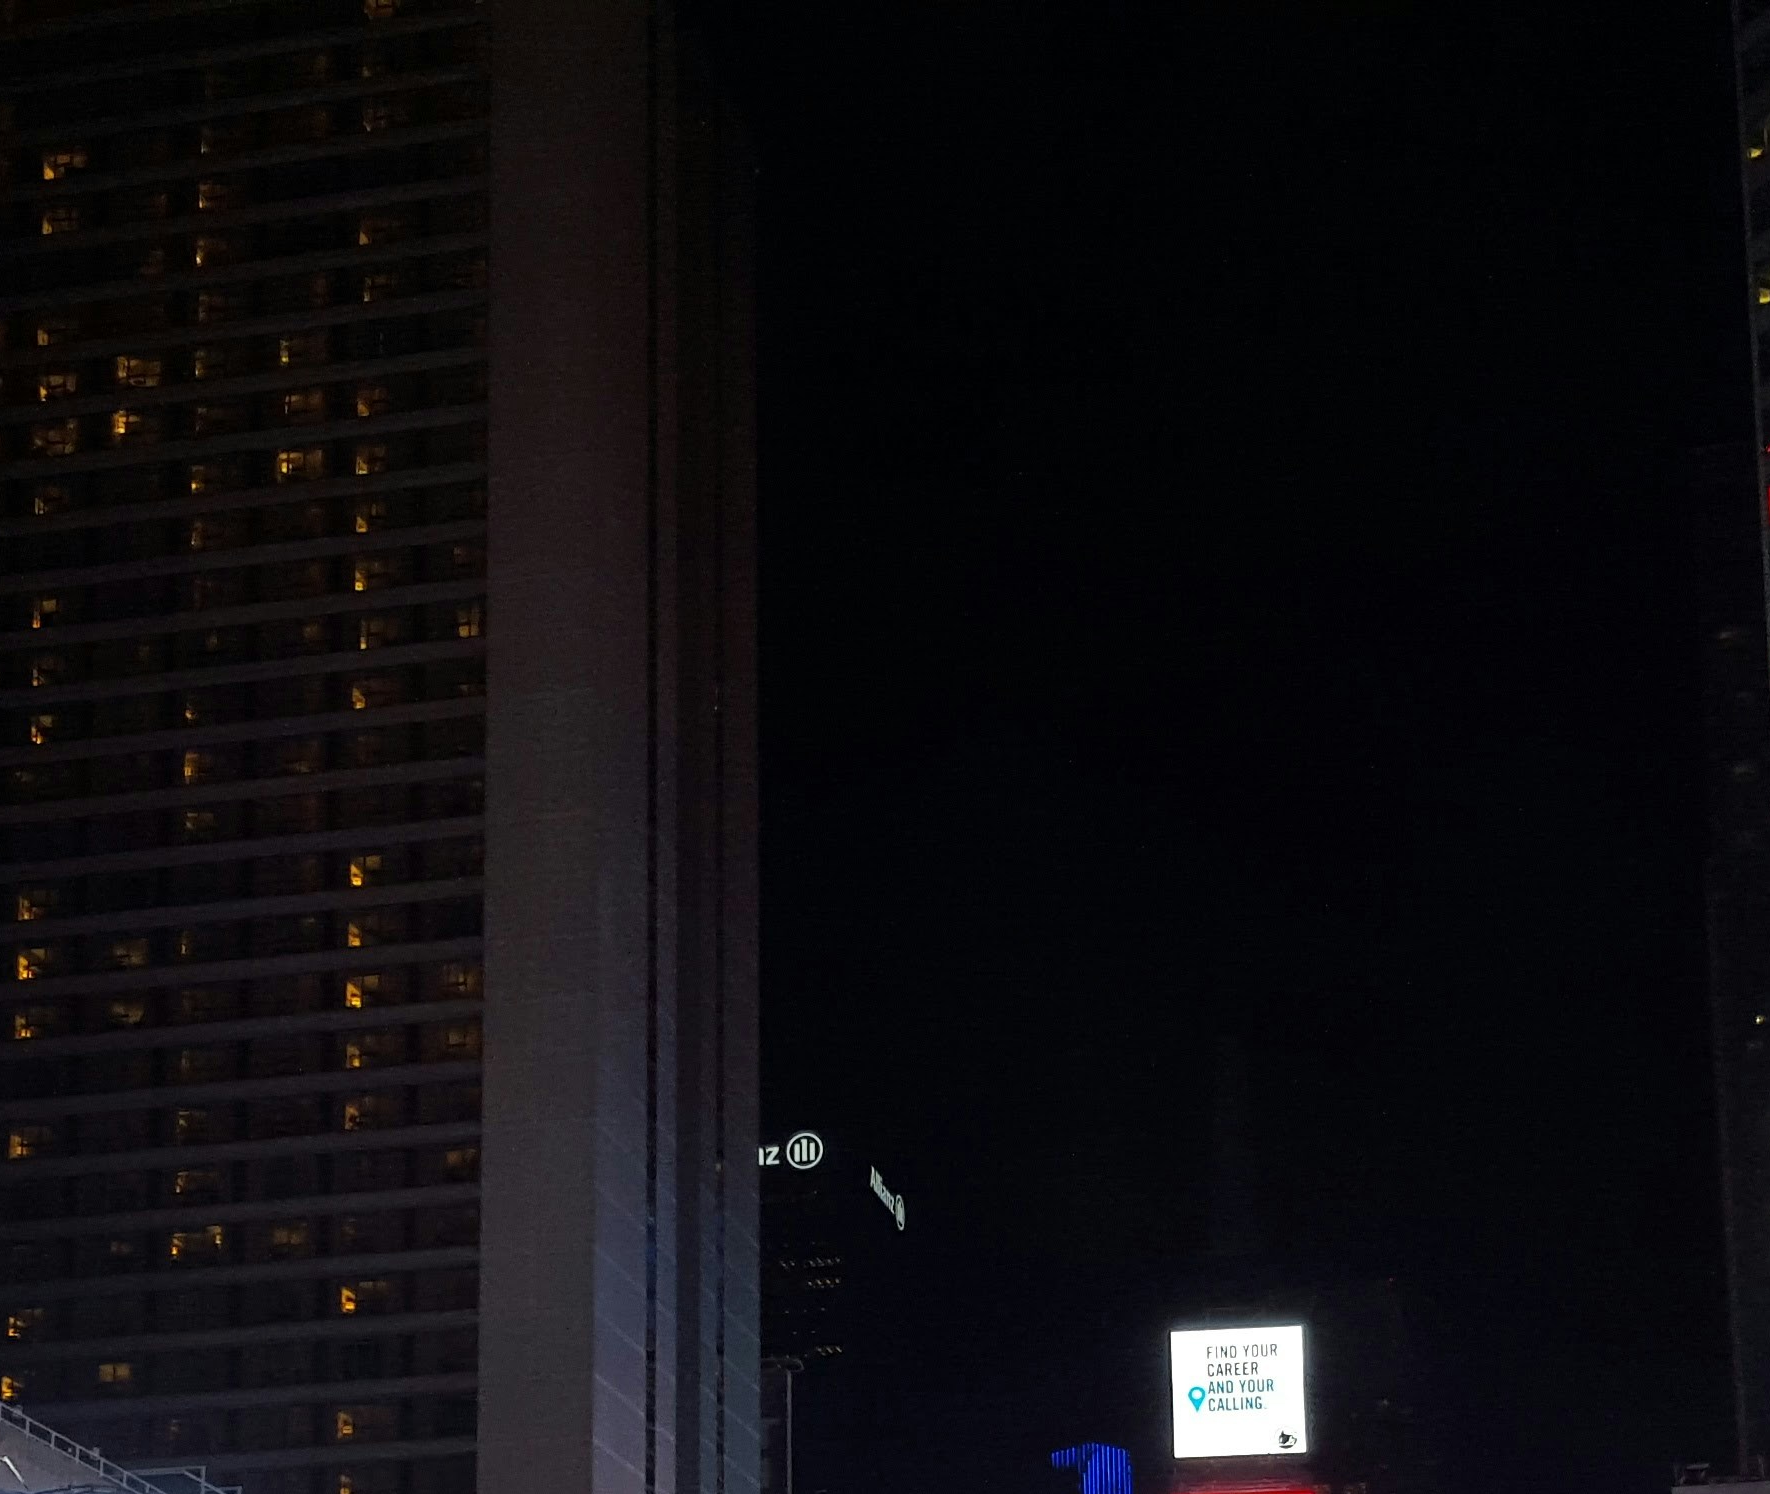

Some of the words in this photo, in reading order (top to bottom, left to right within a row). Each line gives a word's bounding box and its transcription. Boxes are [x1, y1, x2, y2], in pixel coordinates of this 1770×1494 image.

[1206, 1345, 1238, 1360] FIND
[1243, 1343, 1278, 1358] YOUR
[1207, 1362, 1258, 1376] CAREER
[1208, 1379, 1234, 1394] AND
[1240, 1378, 1274, 1393] YOUR
